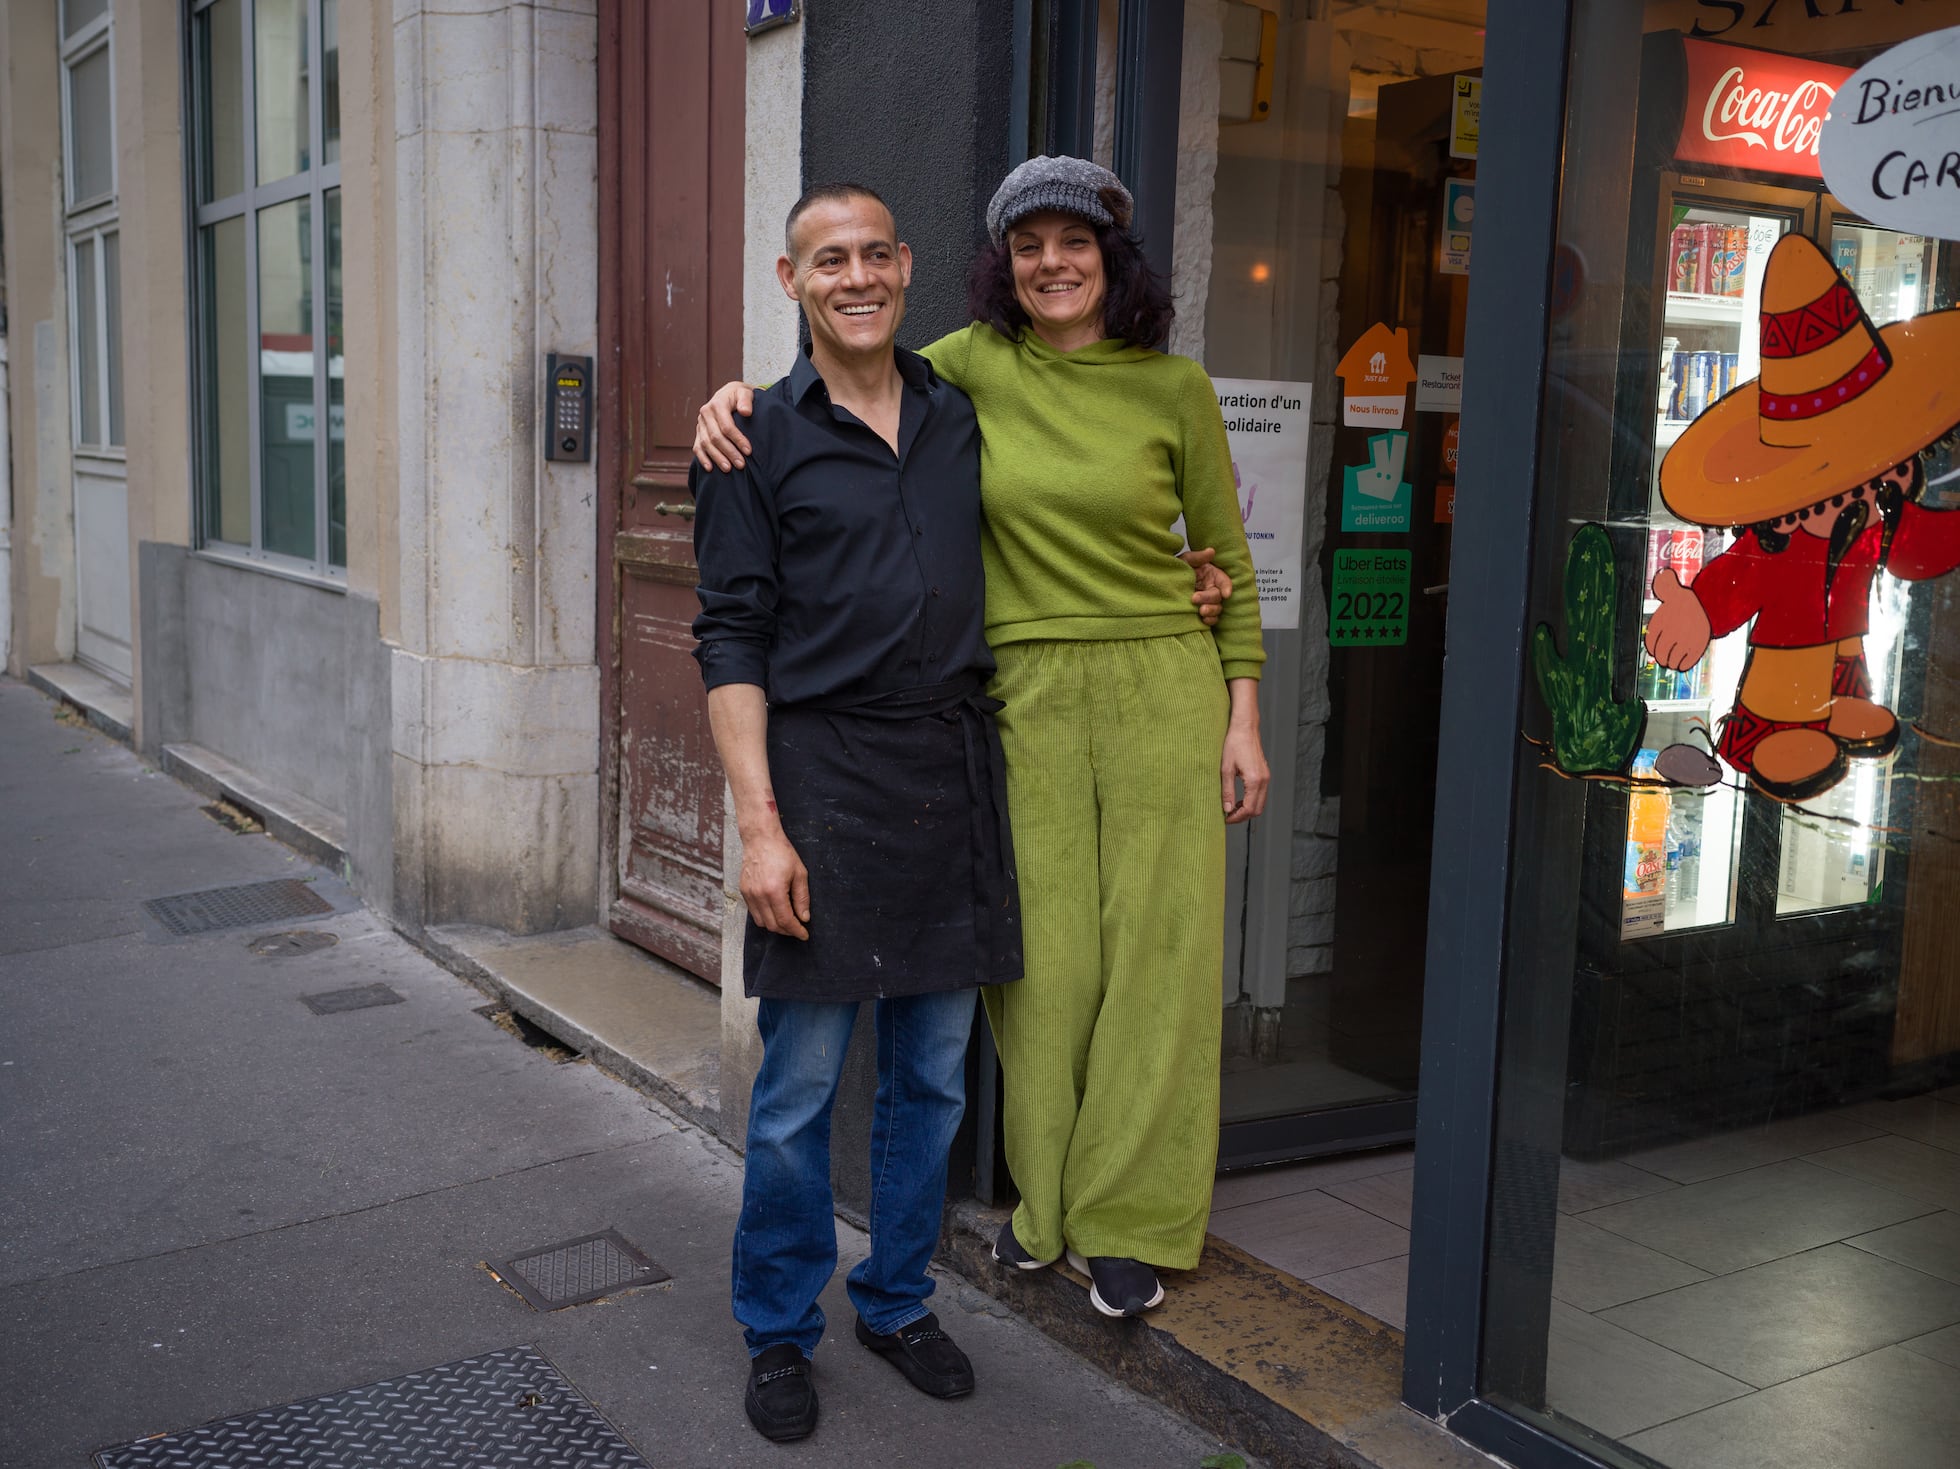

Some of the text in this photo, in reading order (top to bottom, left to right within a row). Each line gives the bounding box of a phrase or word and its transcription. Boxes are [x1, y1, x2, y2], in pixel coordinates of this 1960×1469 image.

[1271, 395, 1301, 411] d'un
[1349, 404, 1399, 415] Nous livrons
[1354, 513, 1405, 526] deliveroo
[1338, 555, 1407, 571] Uber Eats
[1336, 592, 1404, 620] 2022
